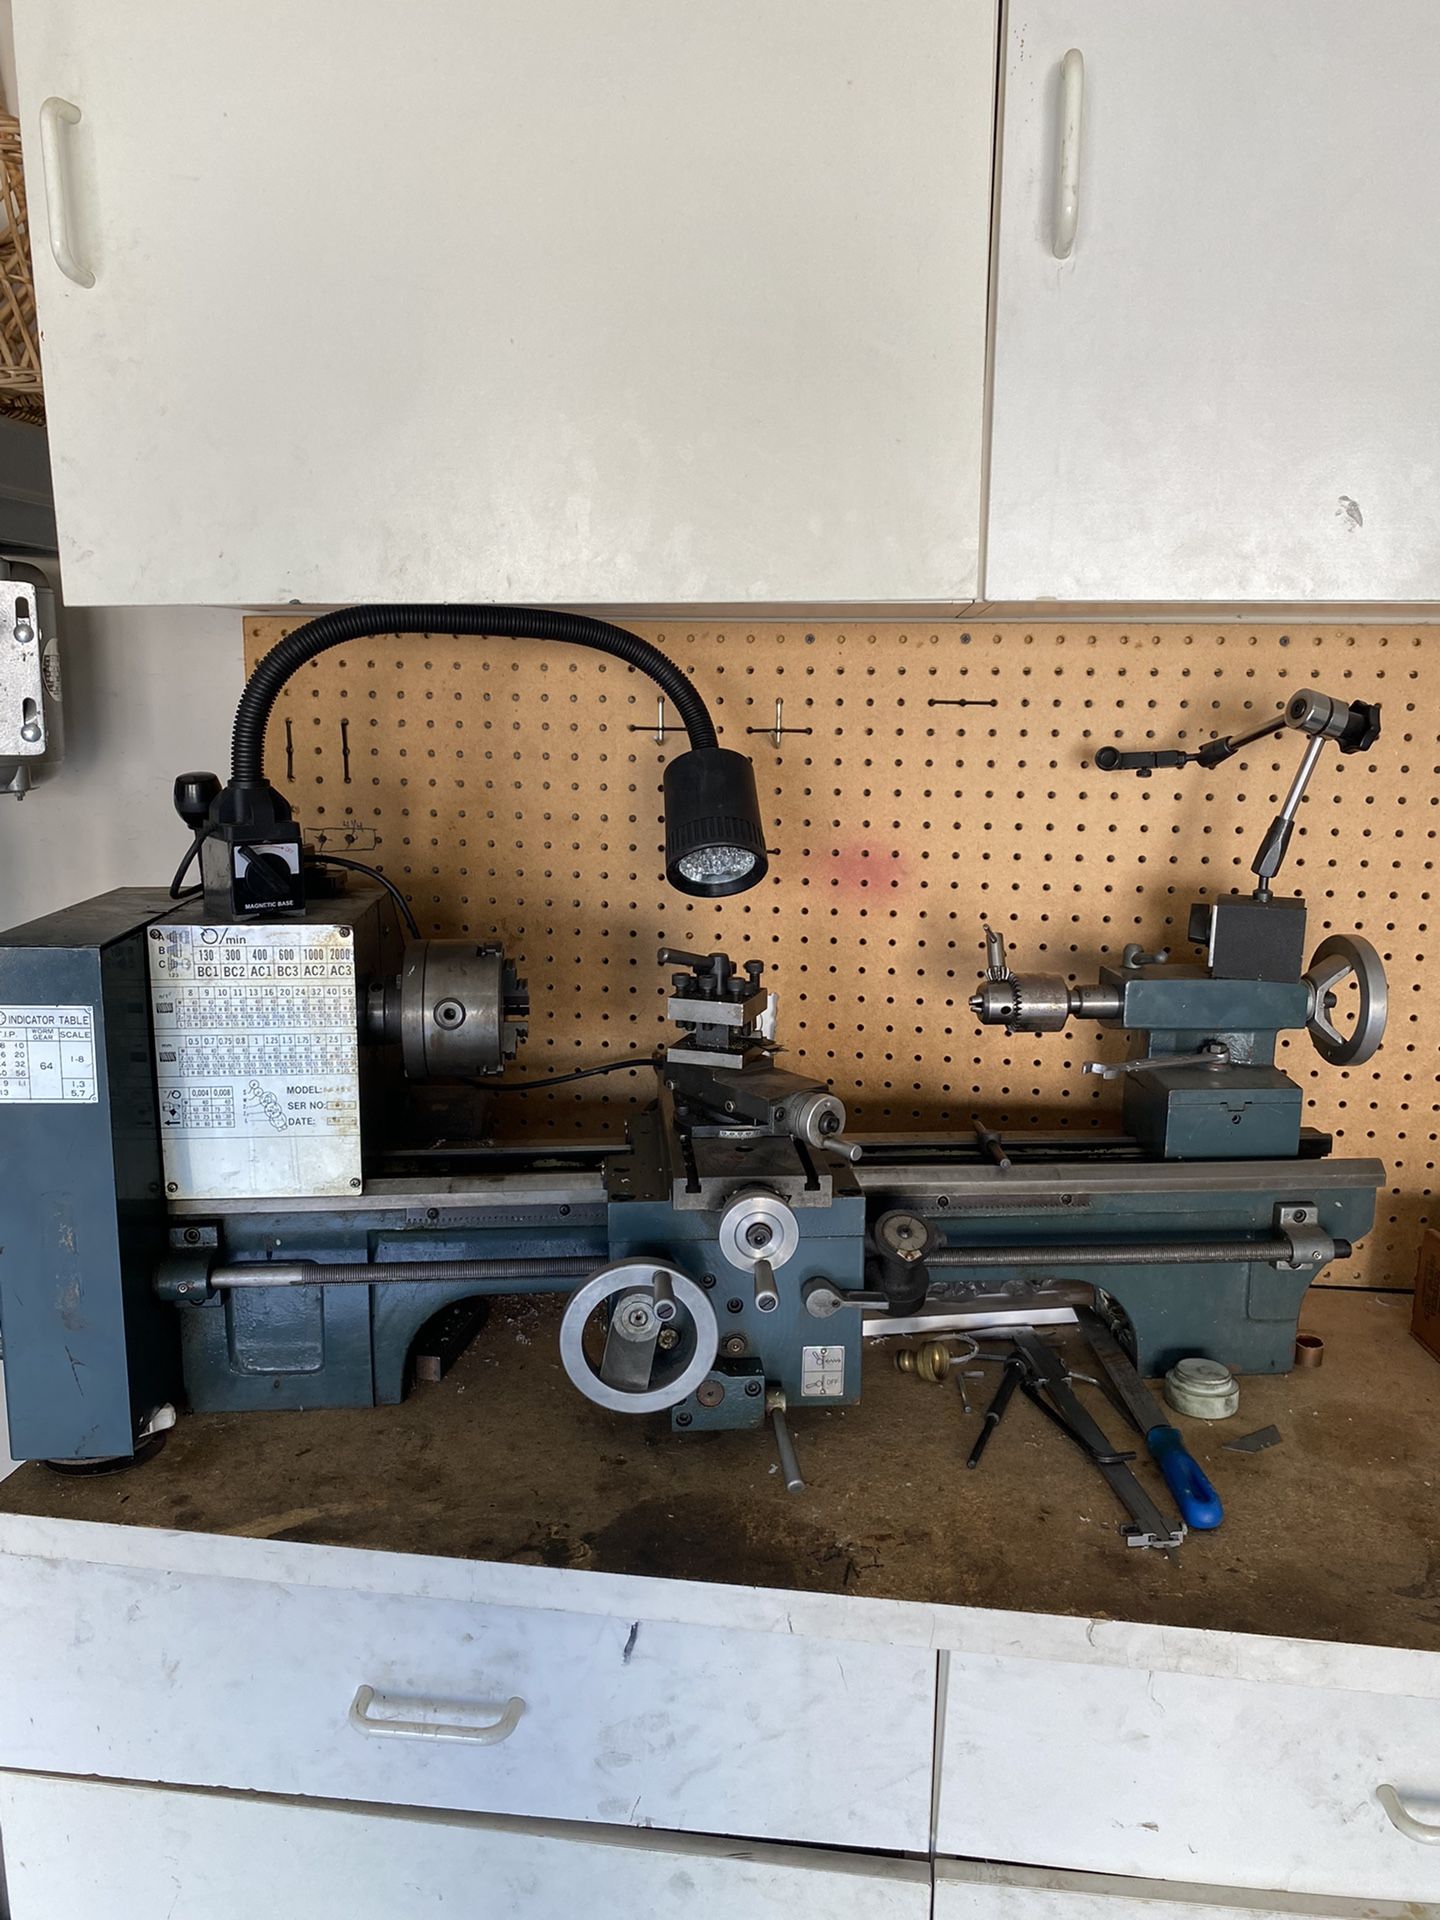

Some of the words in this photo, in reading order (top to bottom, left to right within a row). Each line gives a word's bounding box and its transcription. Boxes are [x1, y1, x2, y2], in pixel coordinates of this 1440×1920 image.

[244, 902, 276, 910] MAGNETIC
[158, 946, 165, 955] B
[199, 949, 214, 961] 130
[225, 949, 240, 961] 300
[252, 948, 267, 961] 400
[278, 948, 294, 961] 600
[303, 948, 324, 961] 1000
[330, 948, 350, 960] 2000
[158, 960, 166, 969] C
[197, 966, 219, 977] BC1
[223, 966, 245, 977] BC2
[250, 966, 272, 977] AC1
[277, 966, 298, 977] BC3
[303, 965, 325, 976] AC2
[330, 965, 352, 976] AC3
[234, 988, 242, 996] 11
[264, 988, 274, 996] 16
[280, 988, 291, 996] 20
[295, 988, 305, 996] 24
[311, 988, 322, 996] 32
[8, 1015, 55, 1025] INDICATOR
[59, 1015, 89, 1025] TABLE
[60, 1031, 91, 1039] SCALE
[218, 1037, 232, 1045] 0.75
[235, 1037, 246, 1045] 0.8
[297, 1036, 309, 1044] 1.75
[15, 1060, 25, 1068] 32
[39, 1061, 53, 1070] 64
[286, 1086, 322, 1095] MODEL:
[287, 1101, 306, 1110] SER
[288, 1117, 316, 1126] DATE:
[826, 1378, 838, 1386] OFF
